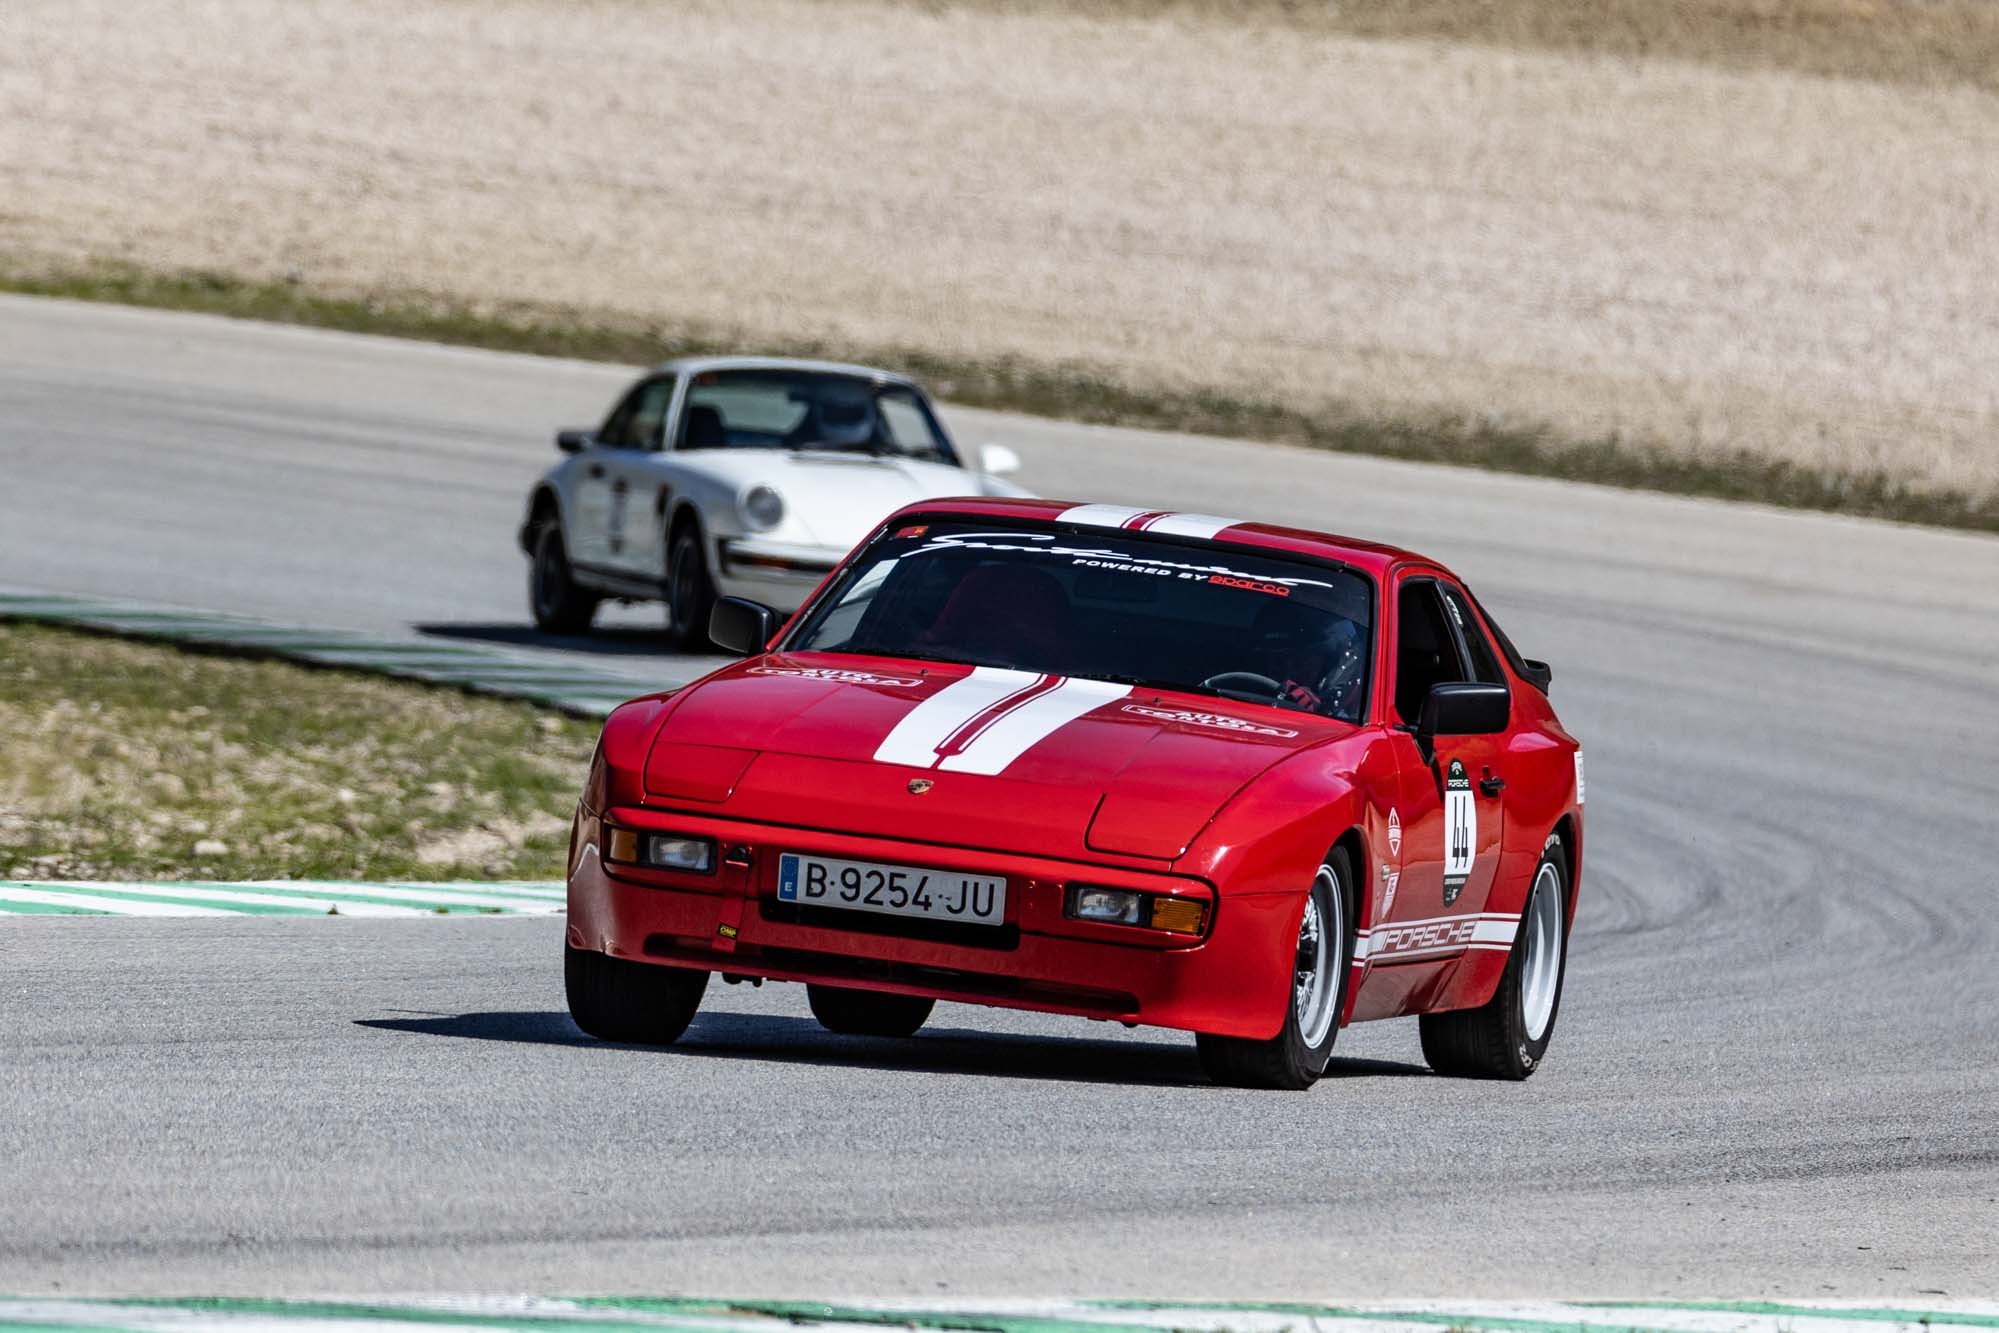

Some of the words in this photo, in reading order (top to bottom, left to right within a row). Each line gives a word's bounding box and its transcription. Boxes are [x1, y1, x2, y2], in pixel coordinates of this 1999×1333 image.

[1072, 558, 1172, 577] POWERED
[1178, 571, 1208, 582] BY
[1208, 574, 1291, 597] sparco
[1452, 795, 1469, 869] 44
[783, 881, 794, 892] E
[1383, 920, 1476, 951] PORSCHE
